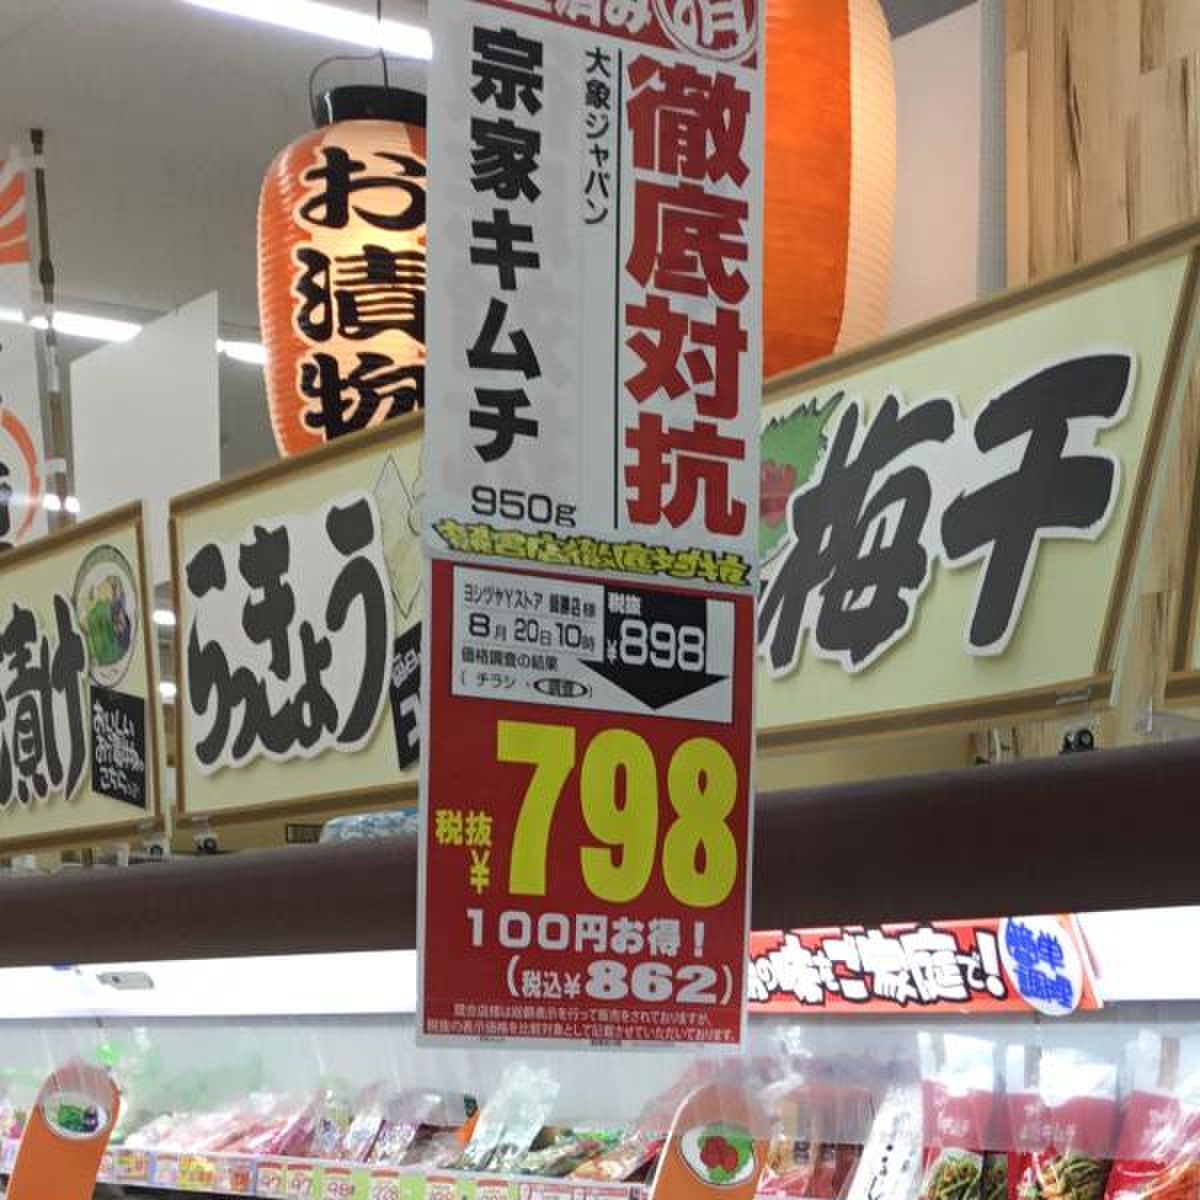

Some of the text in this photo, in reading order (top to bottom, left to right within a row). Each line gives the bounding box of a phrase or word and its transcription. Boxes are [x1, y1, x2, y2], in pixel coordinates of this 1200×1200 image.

[584, 46, 612, 226] 大象ジャパン
[466, 25, 544, 463] 宗家キムチ
[624, 53, 752, 537] 徹底対抗
[471, 485, 577, 527] 950g
[757, 353, 1132, 672] 梅干
[185, 497, 389, 766] らっきょう
[468, 612, 508, 642] 8月
[514, 617, 552, 646] 20日
[435, 809, 494, 848] 税抜
[470, 849, 492, 894] ¥
[496, 720, 738, 908] 798
